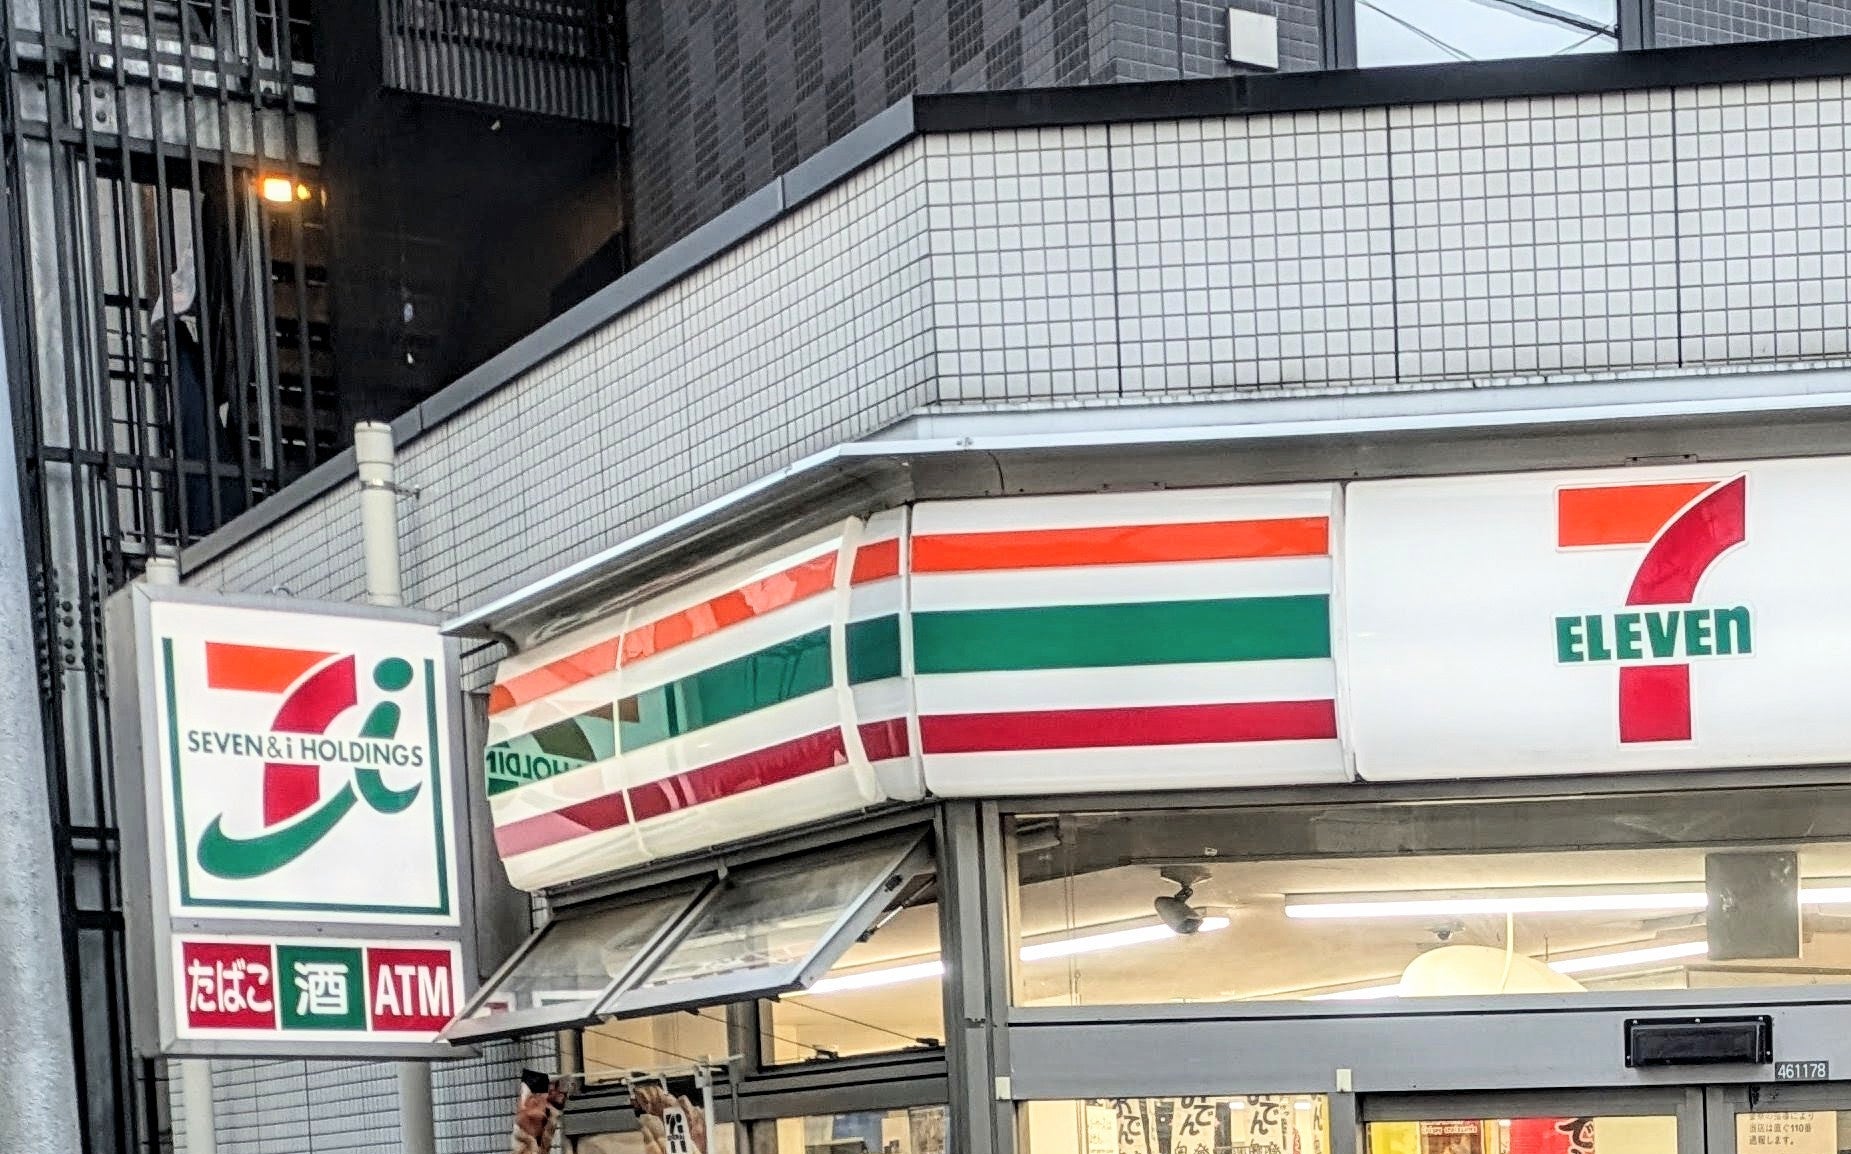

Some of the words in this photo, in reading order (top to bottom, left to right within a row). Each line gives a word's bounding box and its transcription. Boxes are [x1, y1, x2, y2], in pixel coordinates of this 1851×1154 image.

[300, 738, 423, 767] HOLDINGS
[188, 958, 272, 1012] たばこ
[294, 961, 349, 1016] 酒
[374, 964, 451, 1016] ATM
[1777, 1063, 1826, 1078] 461178
